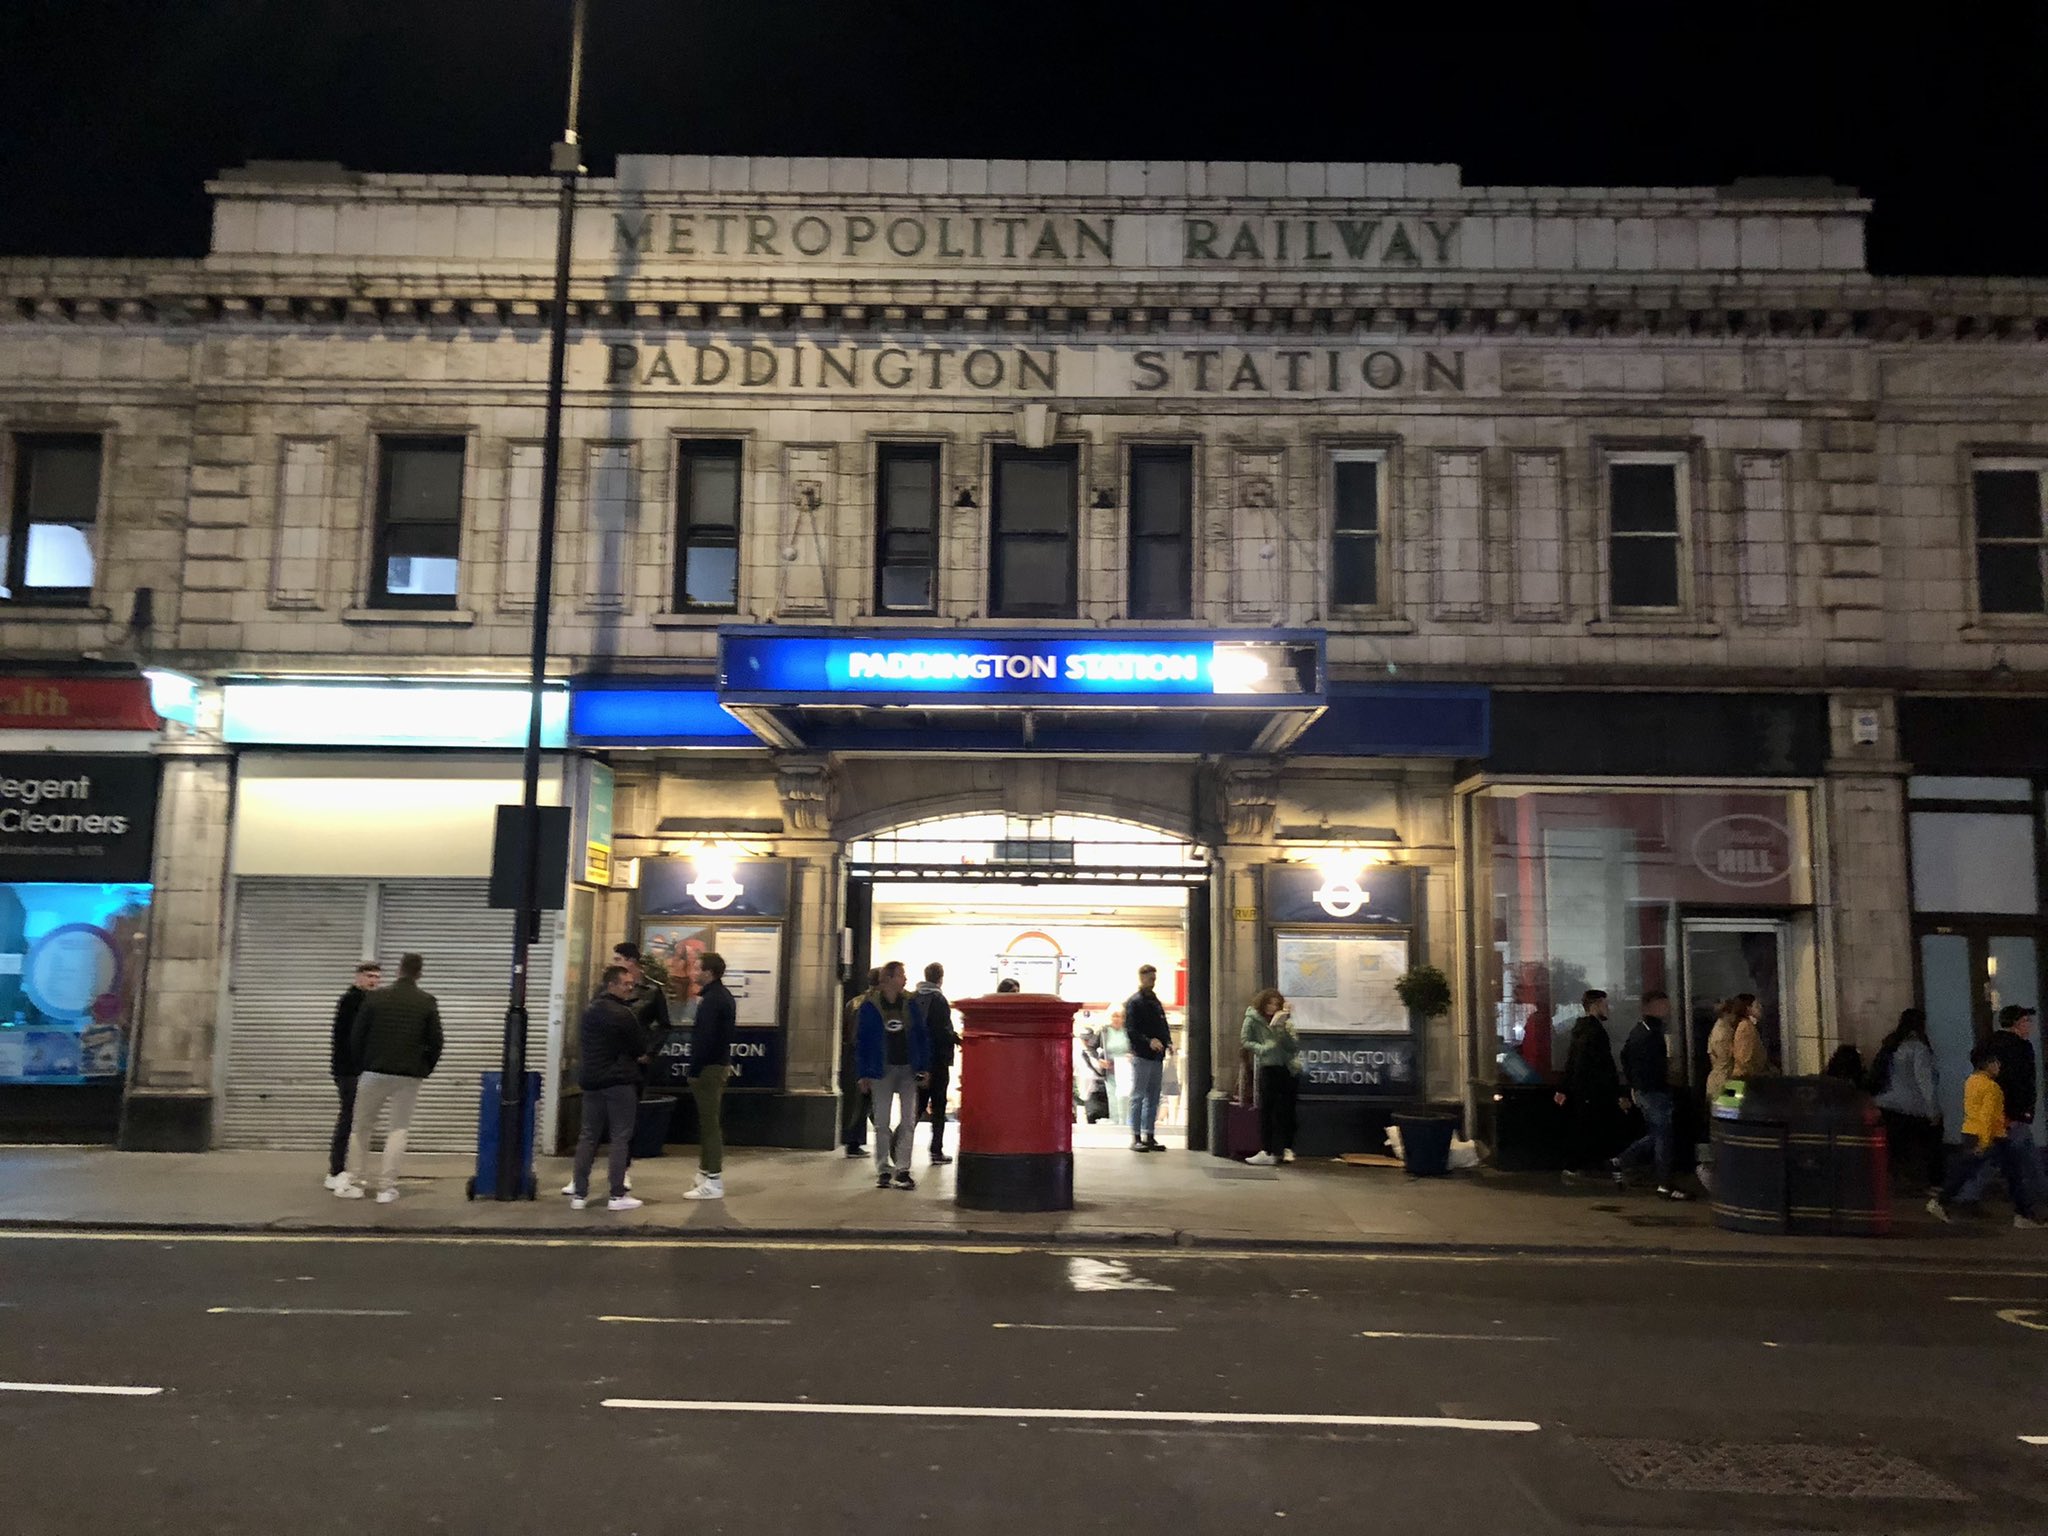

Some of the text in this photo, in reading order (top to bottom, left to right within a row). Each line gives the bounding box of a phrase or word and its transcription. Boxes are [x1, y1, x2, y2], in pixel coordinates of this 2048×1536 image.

[611, 213, 1459, 261] METROPOLITAN RAILWAY
[604, 344, 1465, 392] PADDINGTON STATION
[849, 652, 1197, 680] PADDINGTON STATION
[0, 775, 91, 804] egent
[0, 808, 131, 834] Cleaners
[1718, 849, 1774, 873] HILL
[1297, 1050, 1402, 1065] ADDINGTON
[1309, 1070, 1378, 1084] STATION
